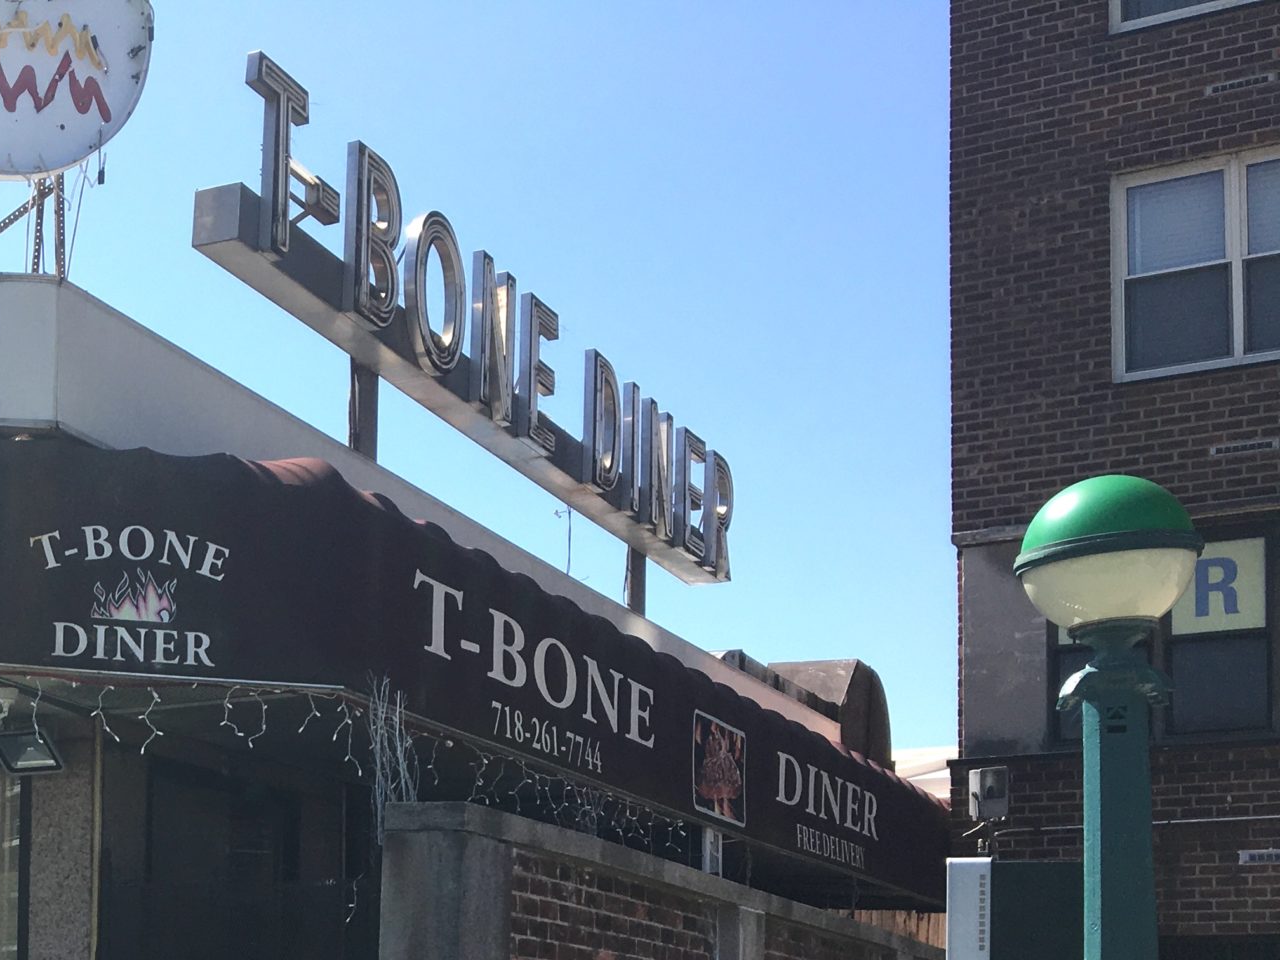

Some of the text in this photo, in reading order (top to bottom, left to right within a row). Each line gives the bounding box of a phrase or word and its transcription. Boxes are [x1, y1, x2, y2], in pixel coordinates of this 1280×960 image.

[246, 50, 734, 582] T-BONE DINER
[30, 525, 230, 581] T-BONE
[1195, 556, 1241, 618] R
[52, 621, 215, 667] DINER
[414, 568, 655, 749] T-BONE
[492, 701, 602, 774] 718-261-7744
[776, 751, 879, 841] DINER
[797, 824, 865, 869] FREE DELIVERY
